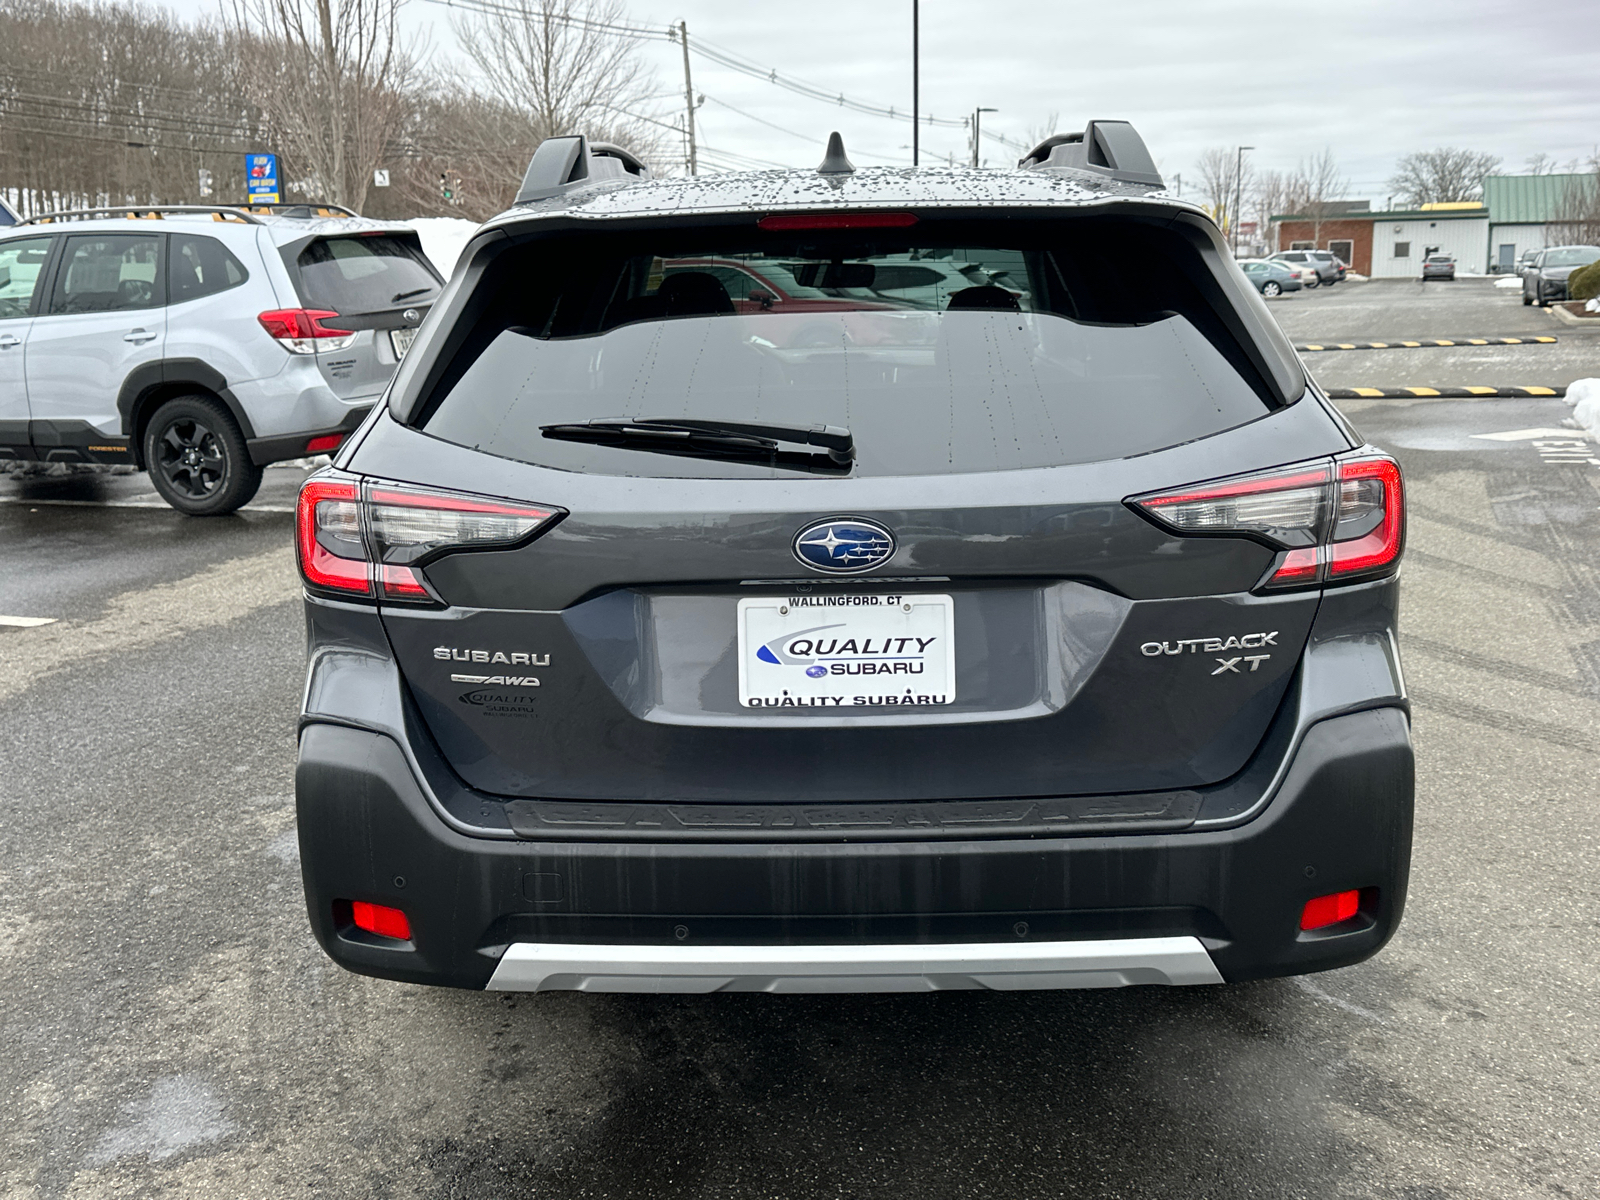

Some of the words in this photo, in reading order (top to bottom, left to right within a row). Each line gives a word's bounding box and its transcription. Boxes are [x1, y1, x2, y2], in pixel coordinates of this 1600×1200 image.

[788, 597, 882, 607] WALLINGFORD,
[887, 596, 903, 605] CT
[789, 637, 937, 656] QUALITY
[1140, 631, 1279, 657] OUTBACK
[433, 646, 550, 666] SUBARU
[830, 662, 924, 676] SUBARU
[1211, 654, 1271, 676] XT
[483, 675, 541, 686] AWD
[472, 694, 537, 704] QUALITY
[748, 696, 843, 707] QUALITY
[853, 694, 946, 706] SUBARU
[485, 705, 534, 713] SUBARU
